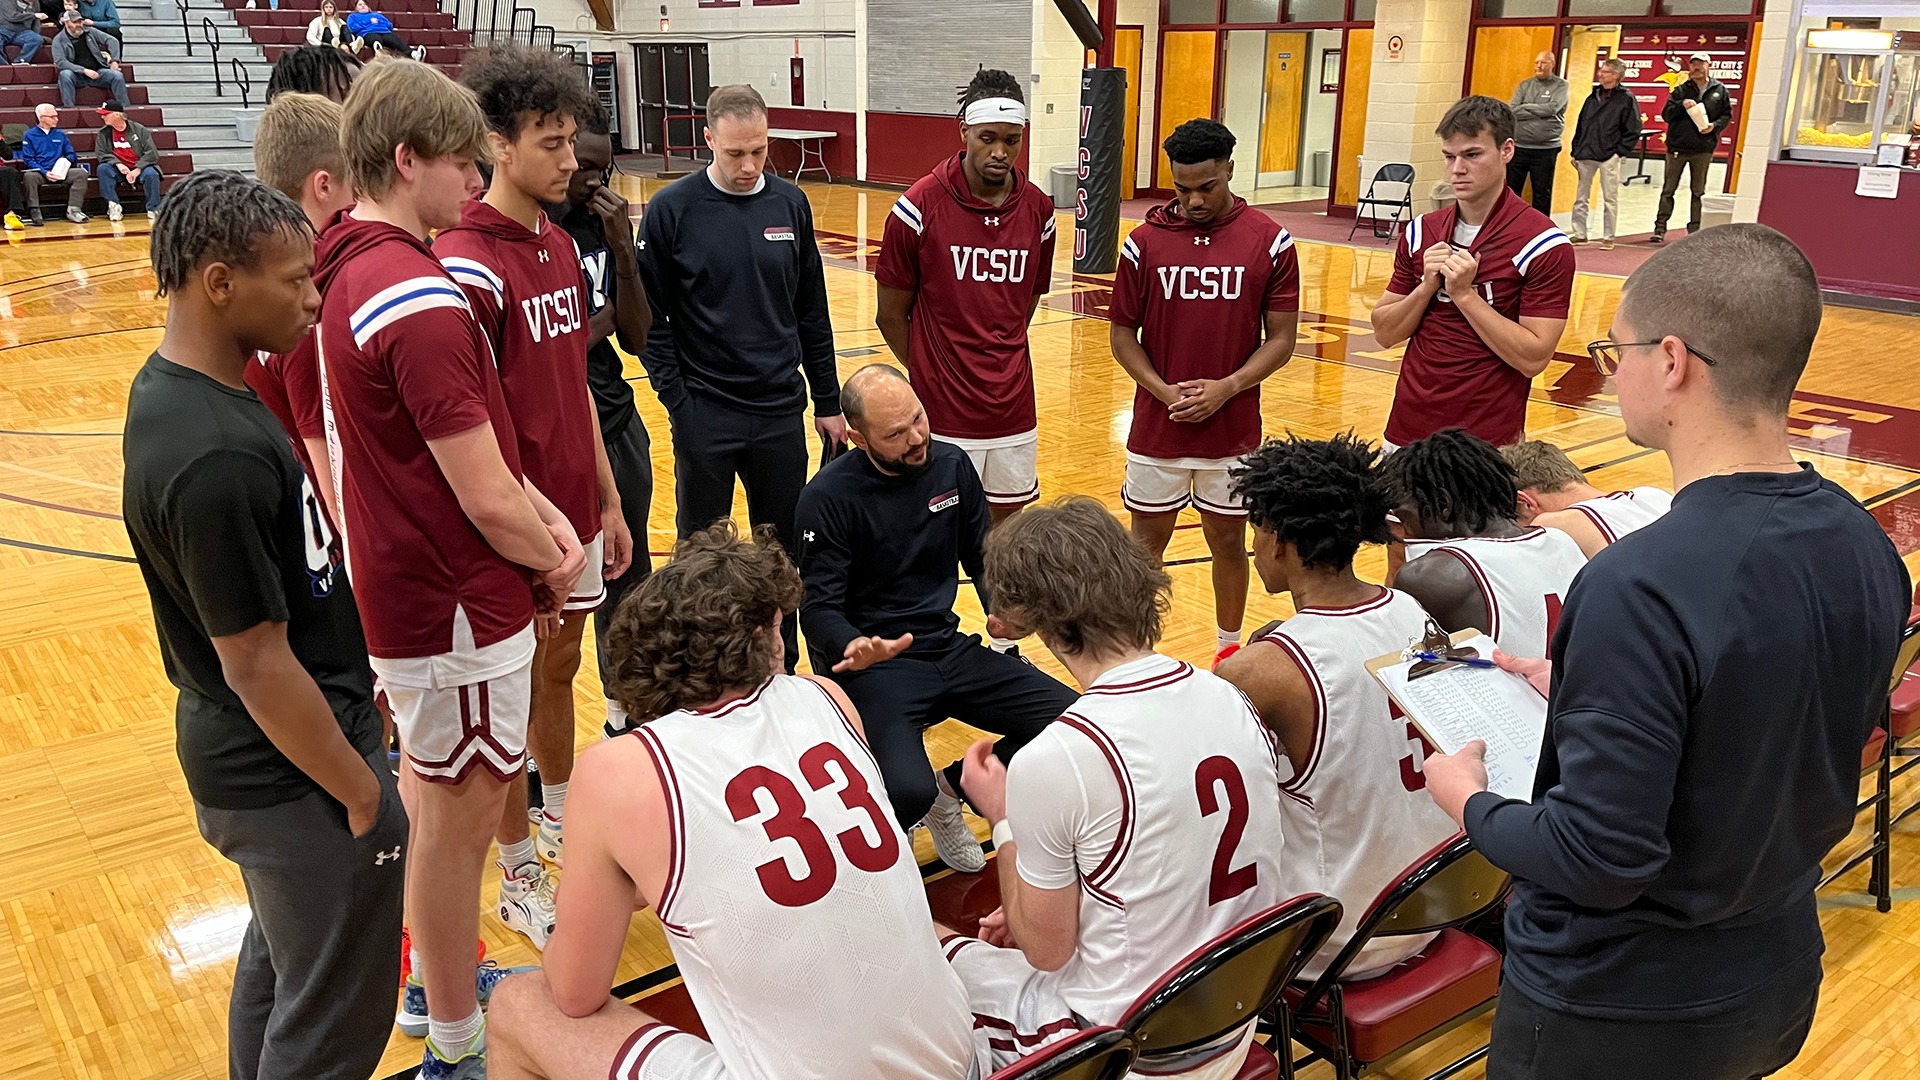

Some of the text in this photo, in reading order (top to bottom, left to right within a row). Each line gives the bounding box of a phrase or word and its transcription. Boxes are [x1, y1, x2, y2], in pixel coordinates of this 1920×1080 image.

[950, 245, 1029, 283] VCSU
[1157, 266, 1245, 300] VCSU
[521, 285, 581, 343] VCSU
[725, 741, 900, 907] 33
[1195, 755, 1258, 907] 2
